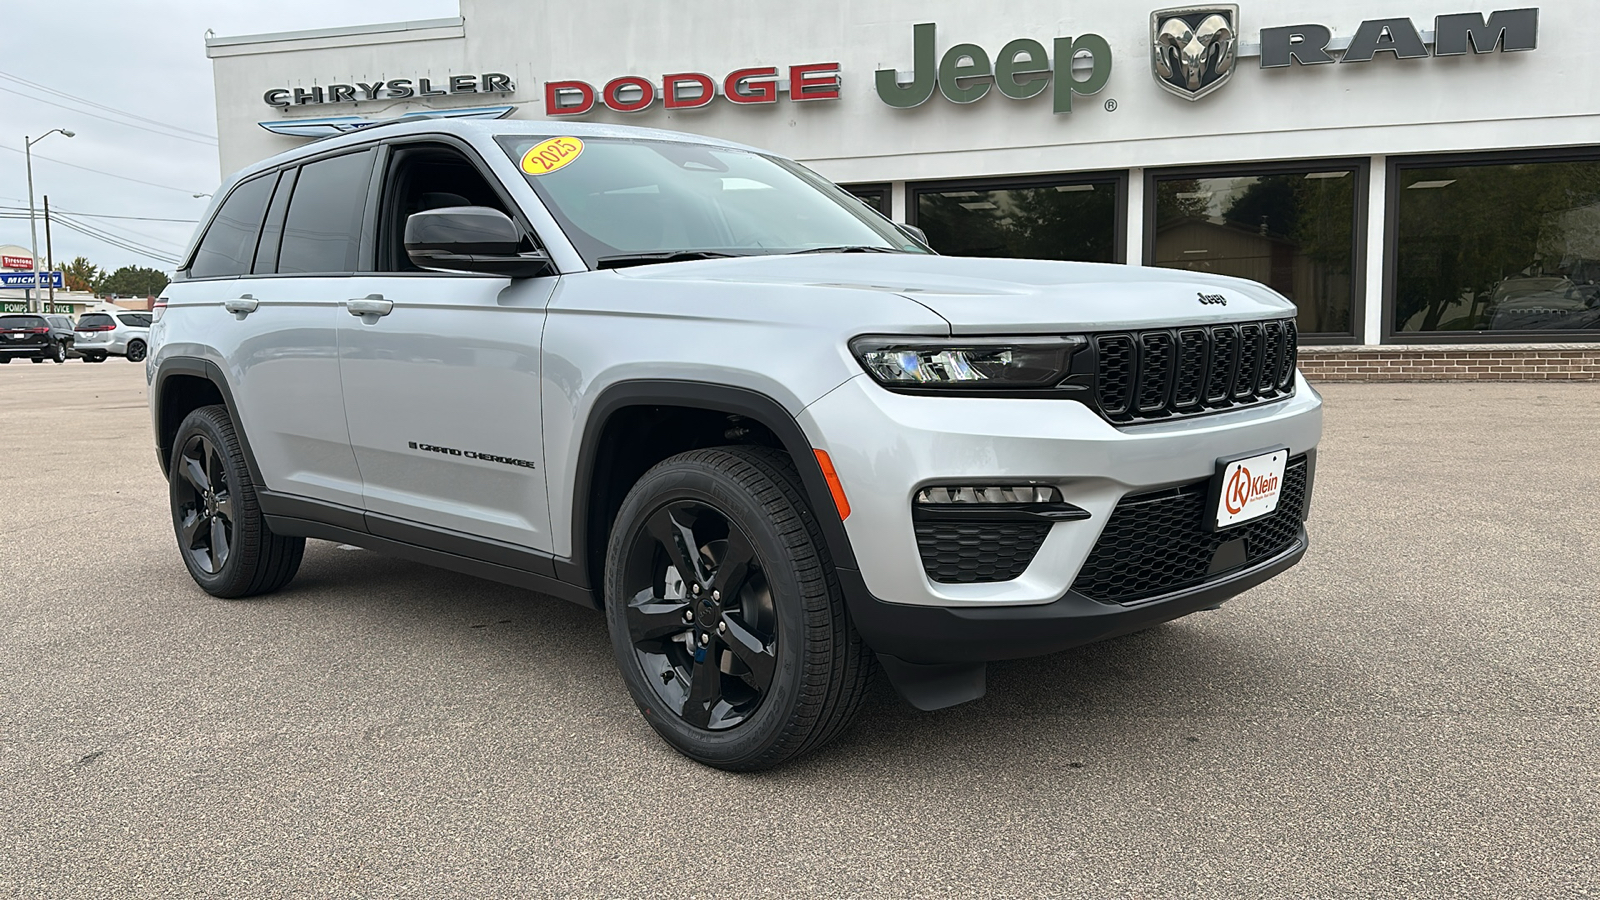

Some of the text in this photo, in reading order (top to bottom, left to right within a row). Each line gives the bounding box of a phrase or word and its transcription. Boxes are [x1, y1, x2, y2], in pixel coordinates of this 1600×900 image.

[1259, 7, 1539, 69] RAM
[875, 22, 1112, 115] Jeep
[263, 72, 513, 107] CHRYSLER
[543, 62, 841, 116] DODGE
[531, 139, 577, 170] 2025
[1197, 292, 1227, 306] Jeep
[419, 443, 535, 469] GRAND CHEROKEE
[1250, 472, 1278, 497] Klein
